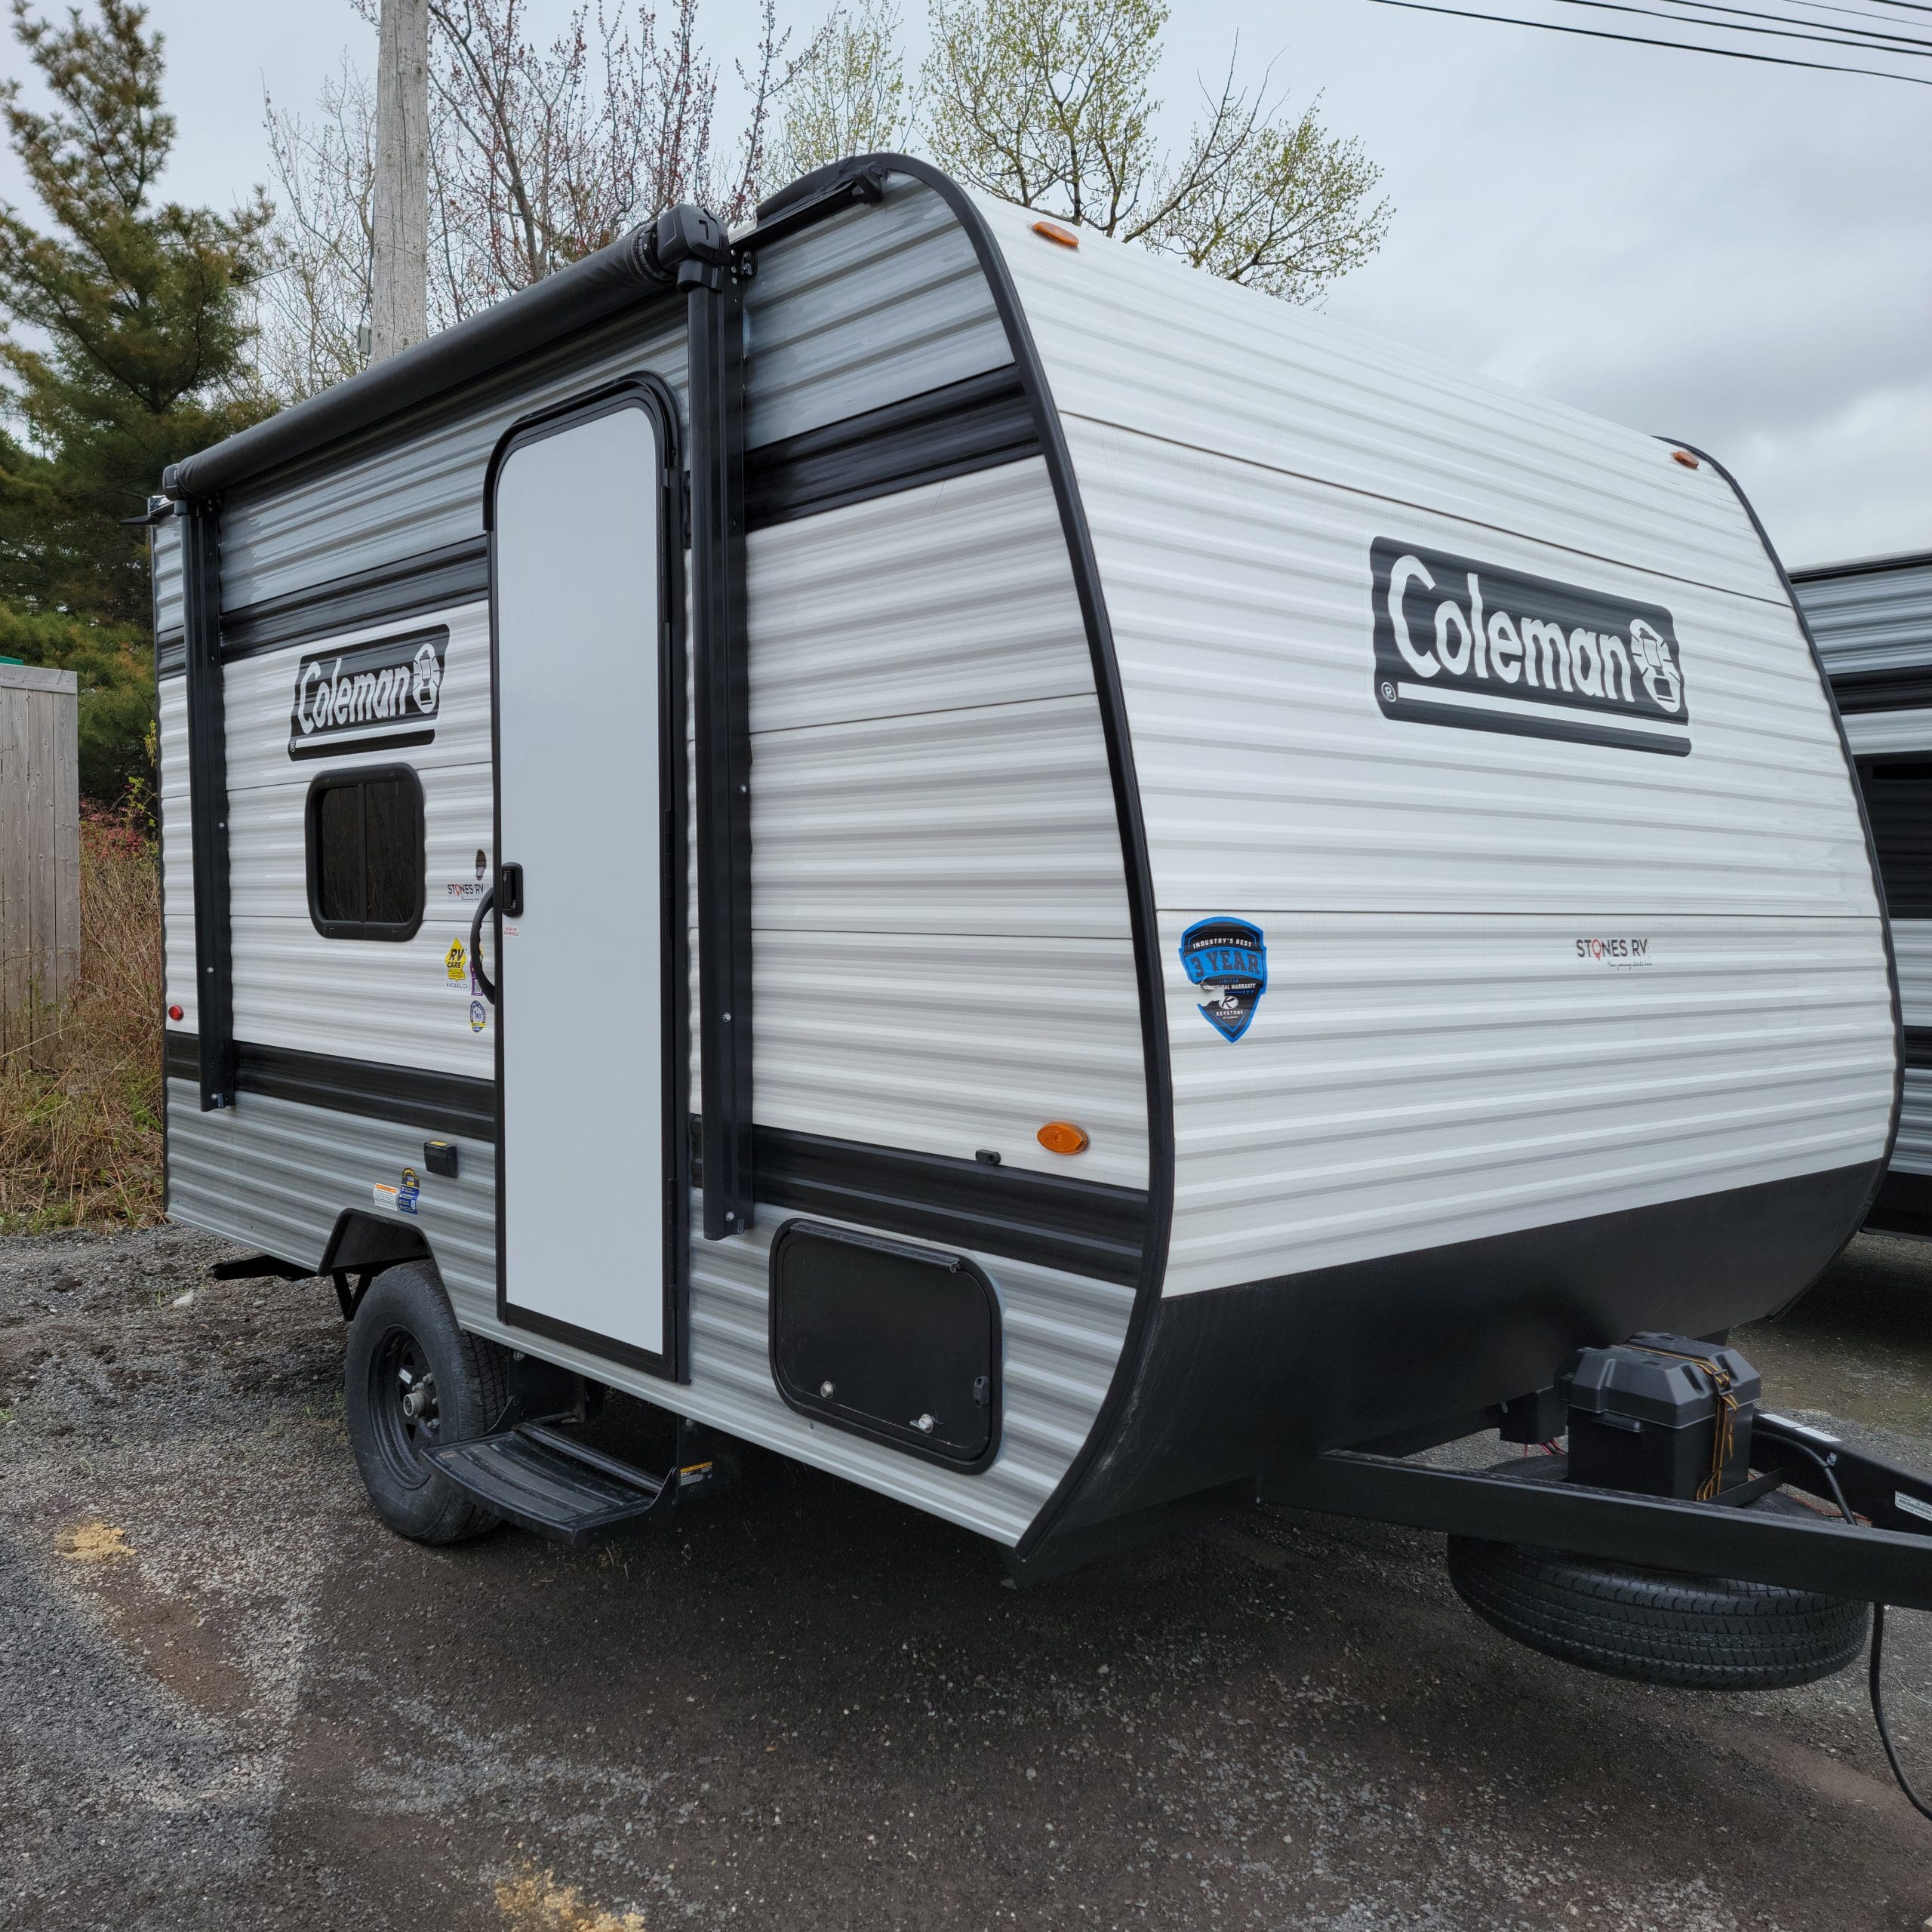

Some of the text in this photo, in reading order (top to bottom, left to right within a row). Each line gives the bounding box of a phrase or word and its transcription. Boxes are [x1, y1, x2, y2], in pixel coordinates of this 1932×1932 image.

[1388, 555, 1635, 702] Coleman
[298, 657, 410, 734] Coleman
[448, 884, 484, 896] STONES RV
[449, 949, 464, 961] RV
[1192, 938, 1252, 949] INDUSTRY'S BEST
[1576, 938, 1647, 961] STONES RV
[1191, 950, 1260, 977] 3 YEAR
